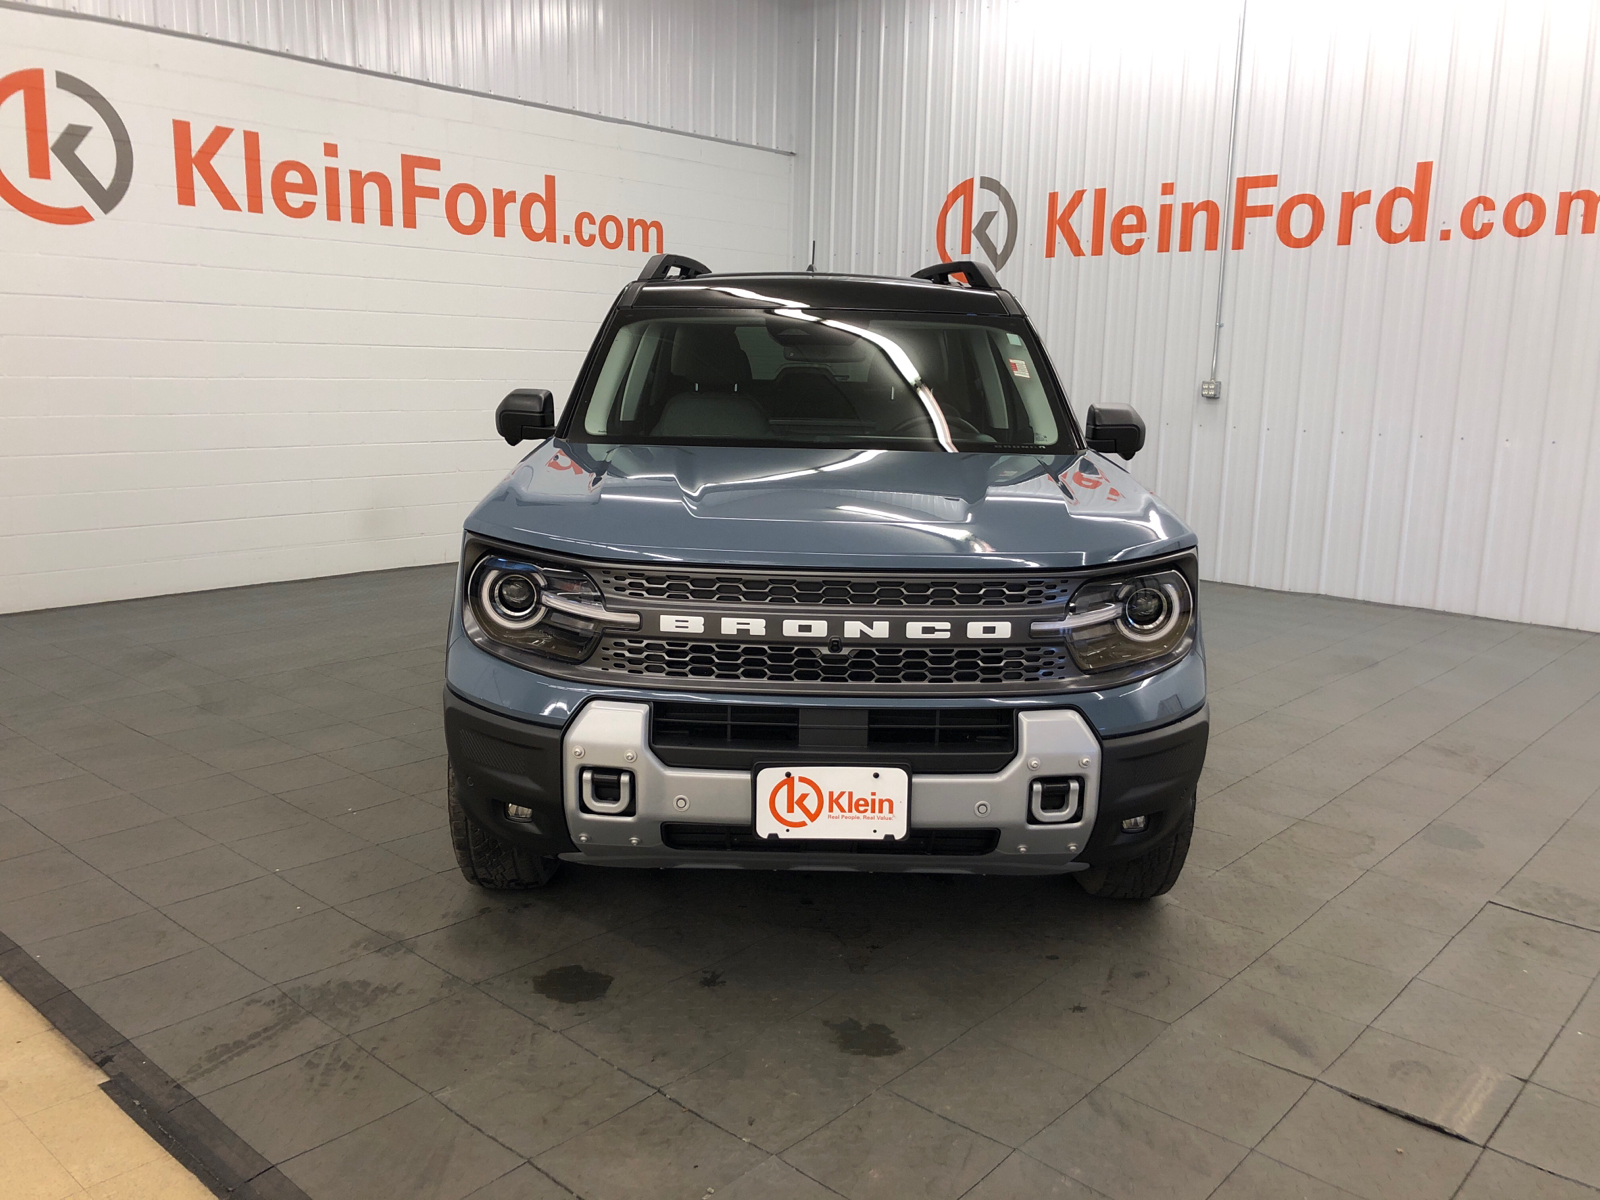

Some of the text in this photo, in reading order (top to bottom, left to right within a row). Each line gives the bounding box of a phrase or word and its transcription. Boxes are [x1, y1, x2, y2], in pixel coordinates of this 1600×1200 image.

[172, 119, 664, 255] KleinFord.com
[1045, 161, 1600, 259] KleinFord.com
[659, 614, 1012, 639] BRONCO
[828, 791, 894, 814] Klein
